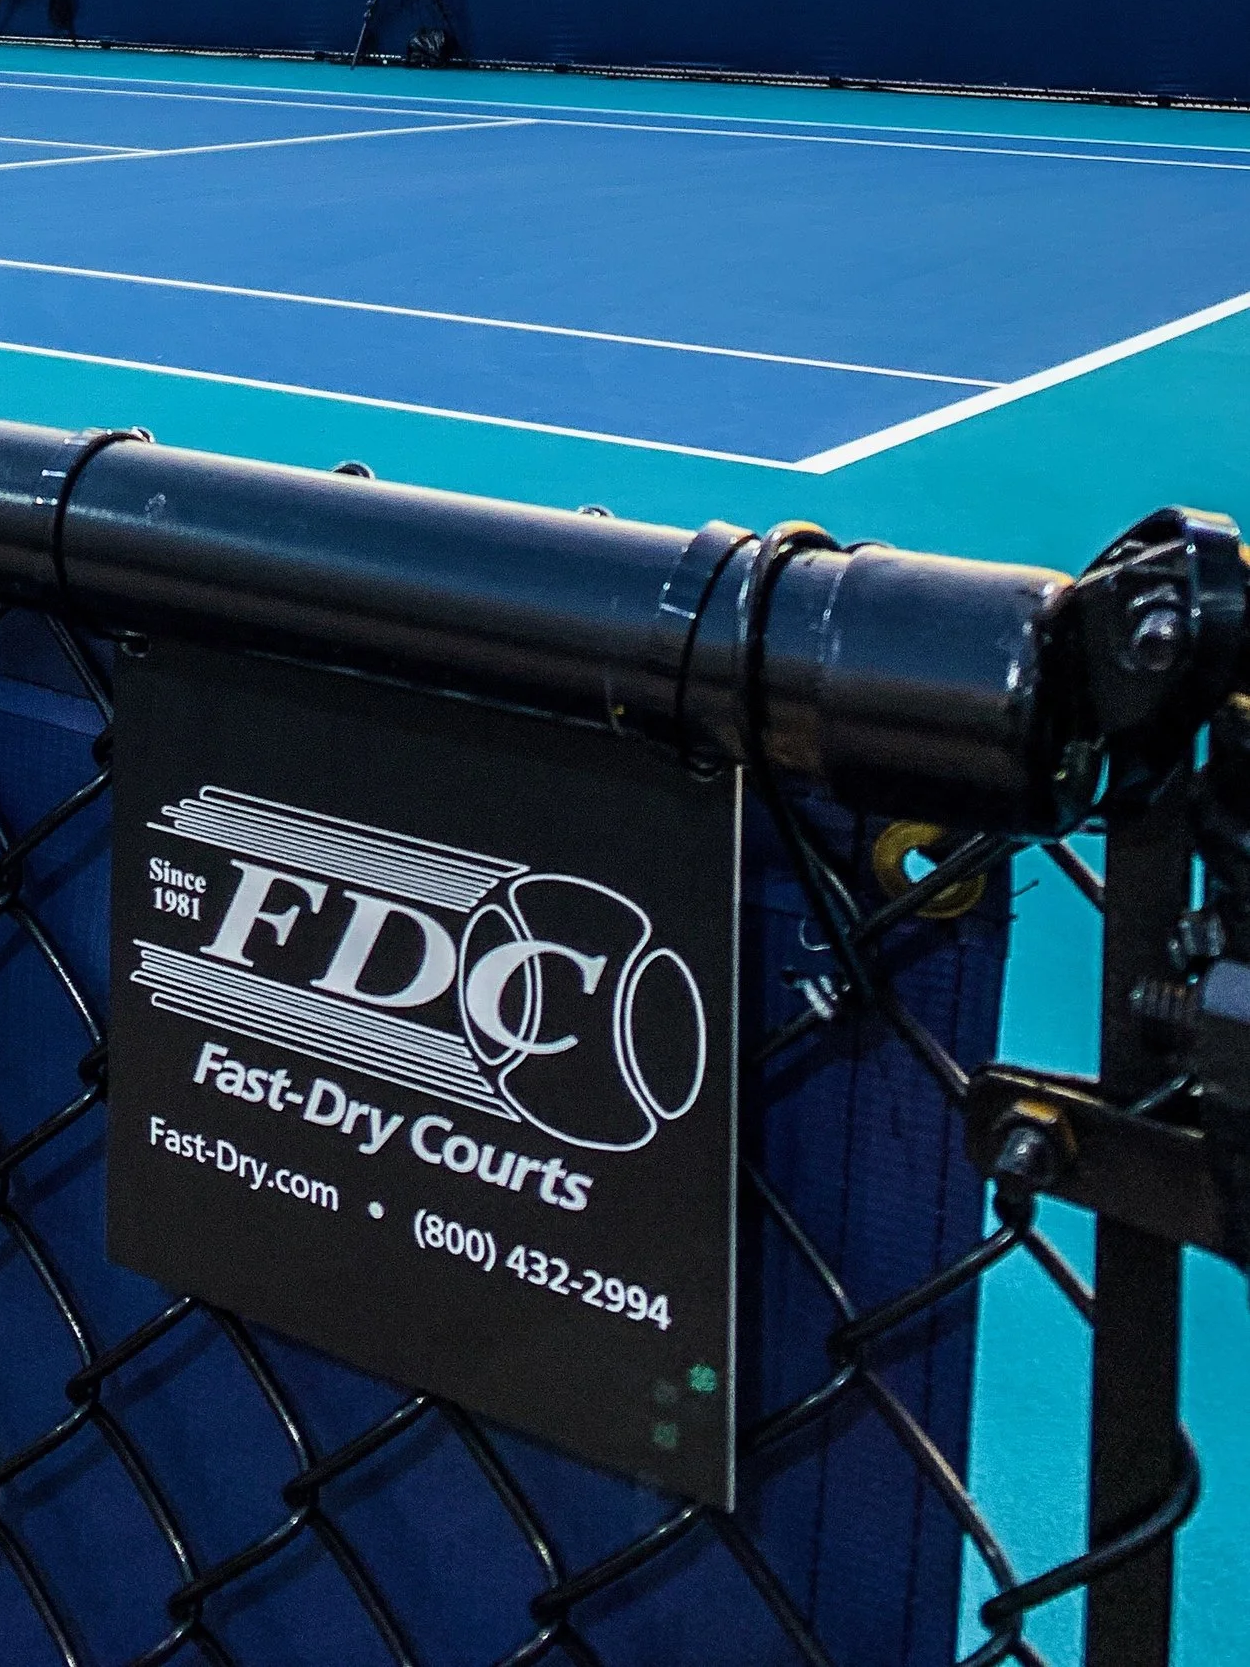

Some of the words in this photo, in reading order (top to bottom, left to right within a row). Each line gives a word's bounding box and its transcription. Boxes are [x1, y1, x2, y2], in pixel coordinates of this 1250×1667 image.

[149, 856, 207, 894] Since
[152, 886, 201, 921] 1981
[200, 859, 608, 1056] FDC
[193, 1041, 405, 1155] Fast-Dry
[410, 1114, 595, 1212] Courts
[150, 1115, 340, 1212] Fast-Dry.com
[414, 1208, 497, 1272] (800)
[505, 1244, 672, 1331] 432-2994
